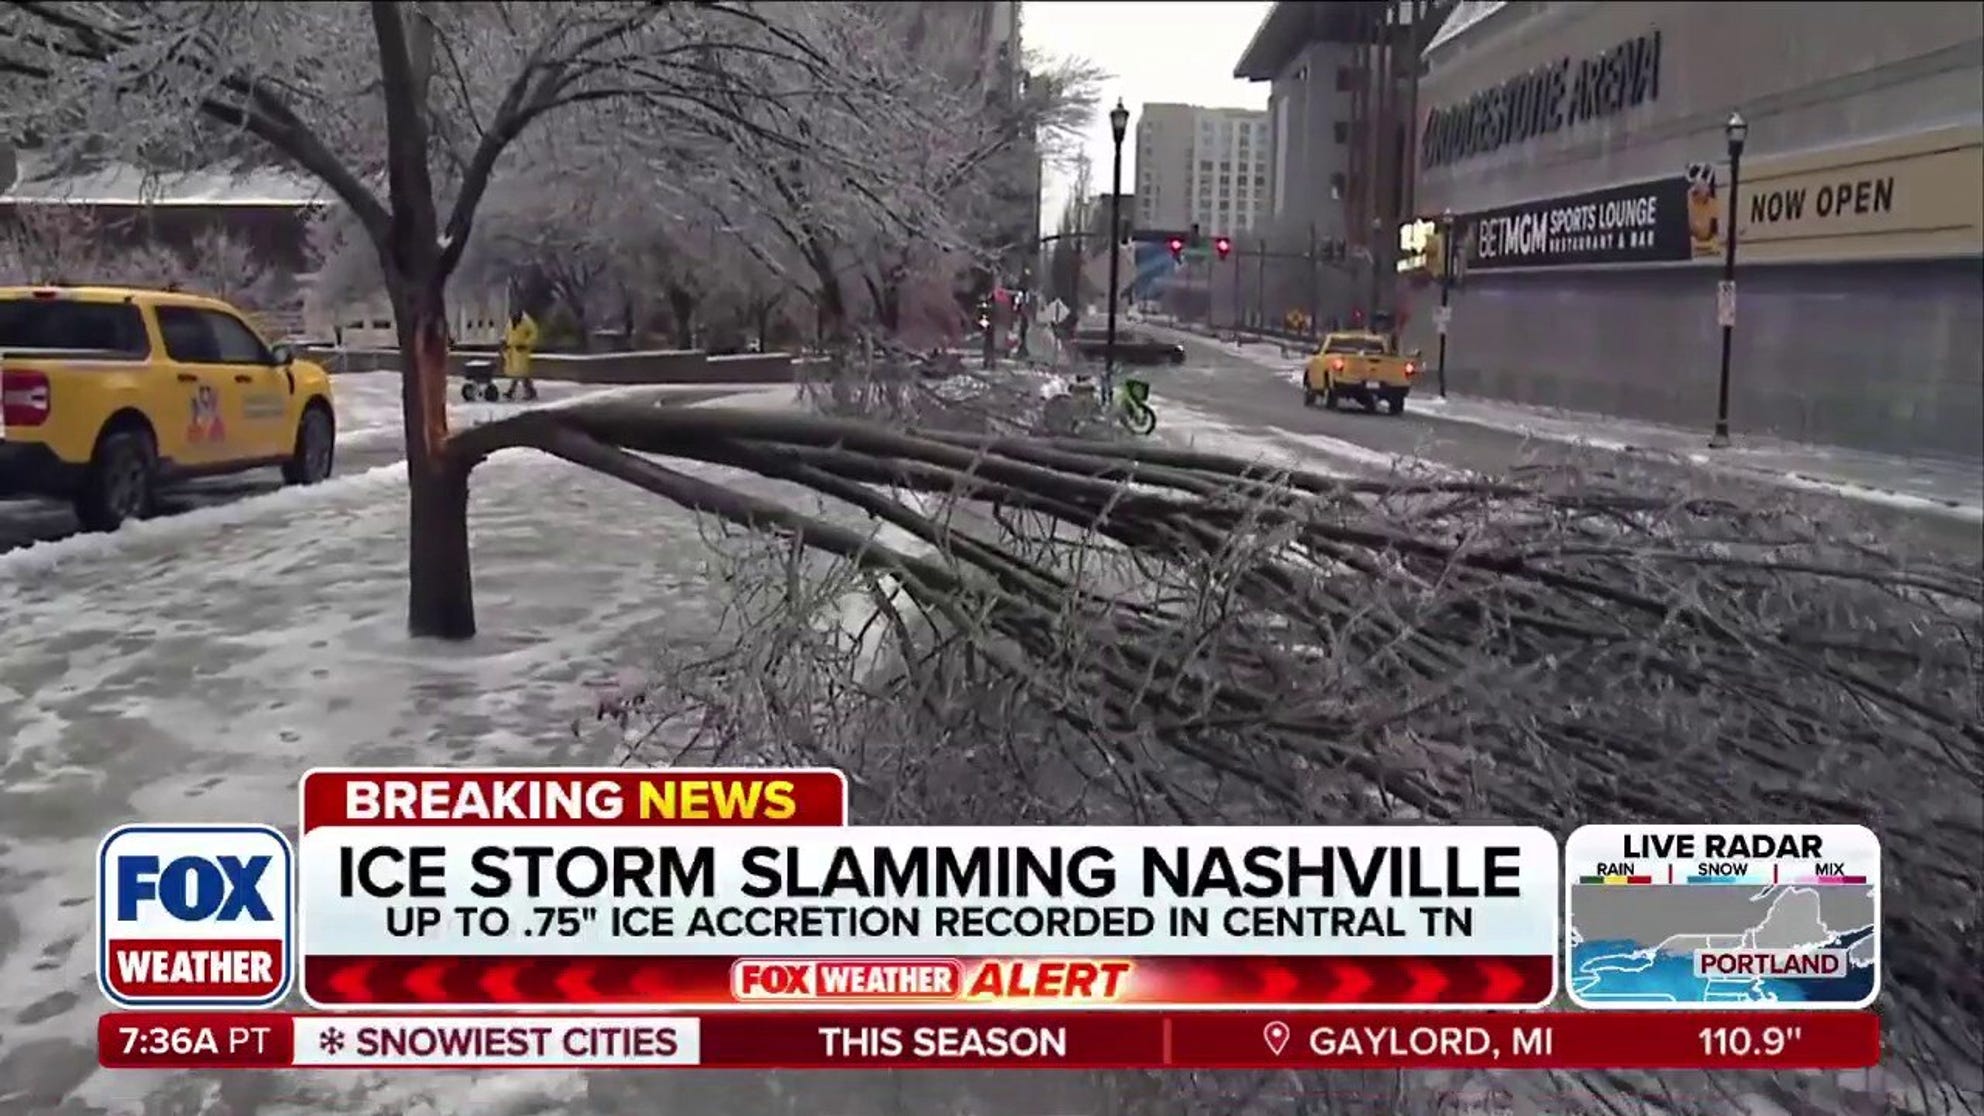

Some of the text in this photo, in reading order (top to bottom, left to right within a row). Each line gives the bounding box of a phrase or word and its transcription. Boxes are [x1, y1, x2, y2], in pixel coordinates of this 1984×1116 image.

[1550, 196, 1657, 234] SPORTS LOUNGE
[1751, 176, 1894, 223] NOW OPEN
[1479, 212, 1548, 258] BETMGM
